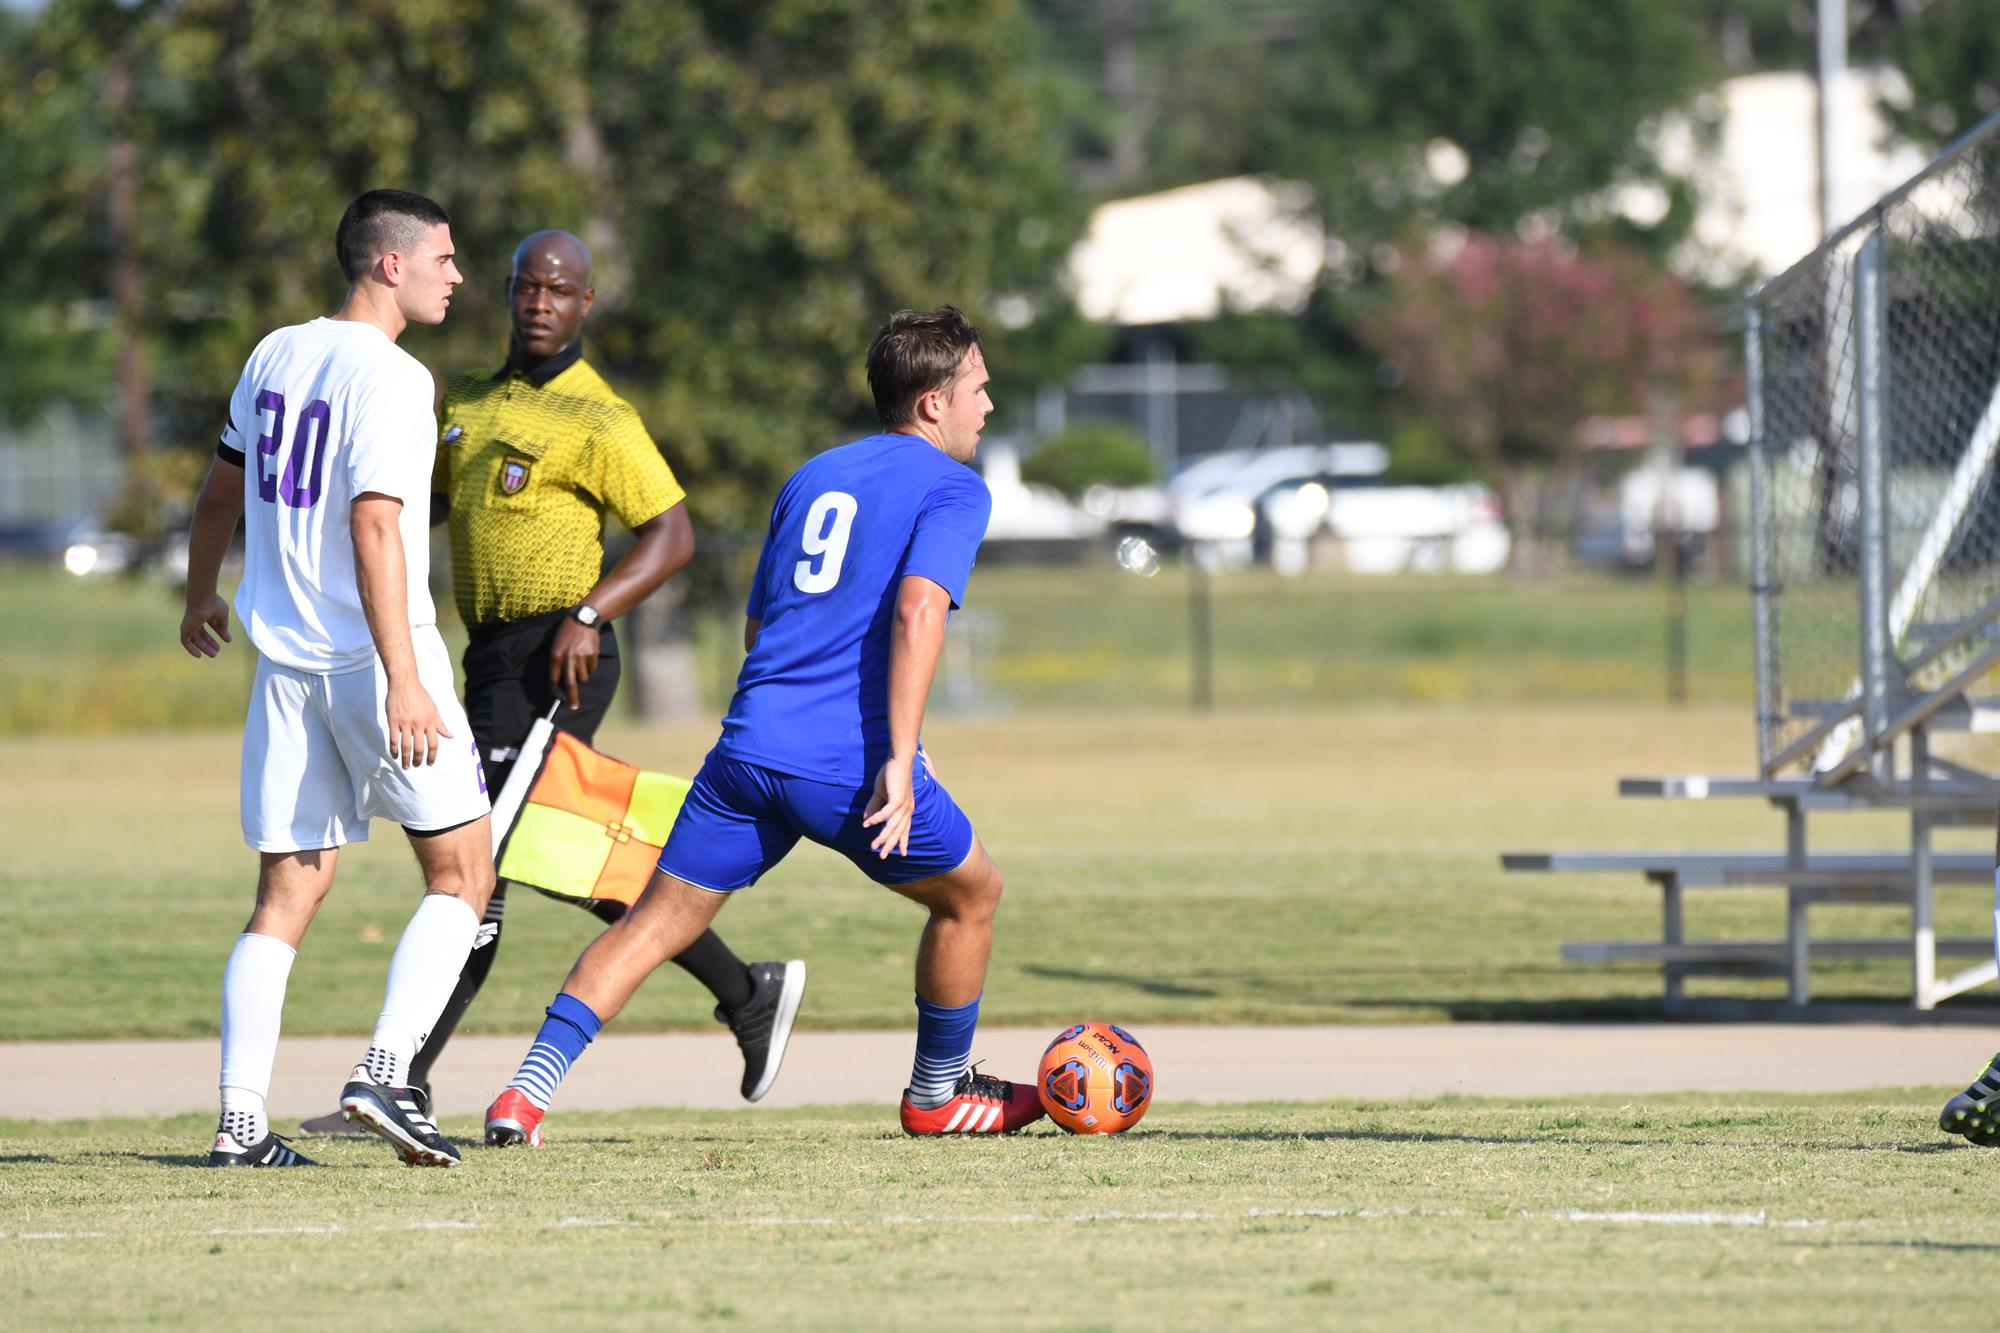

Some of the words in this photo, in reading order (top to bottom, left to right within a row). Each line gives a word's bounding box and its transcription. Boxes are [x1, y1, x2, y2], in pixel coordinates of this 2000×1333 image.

[256, 389, 330, 508] 20
[794, 491, 858, 594] 9
[1078, 1040, 1107, 1070] Wilson
[1093, 1032, 1121, 1055] NCAA
